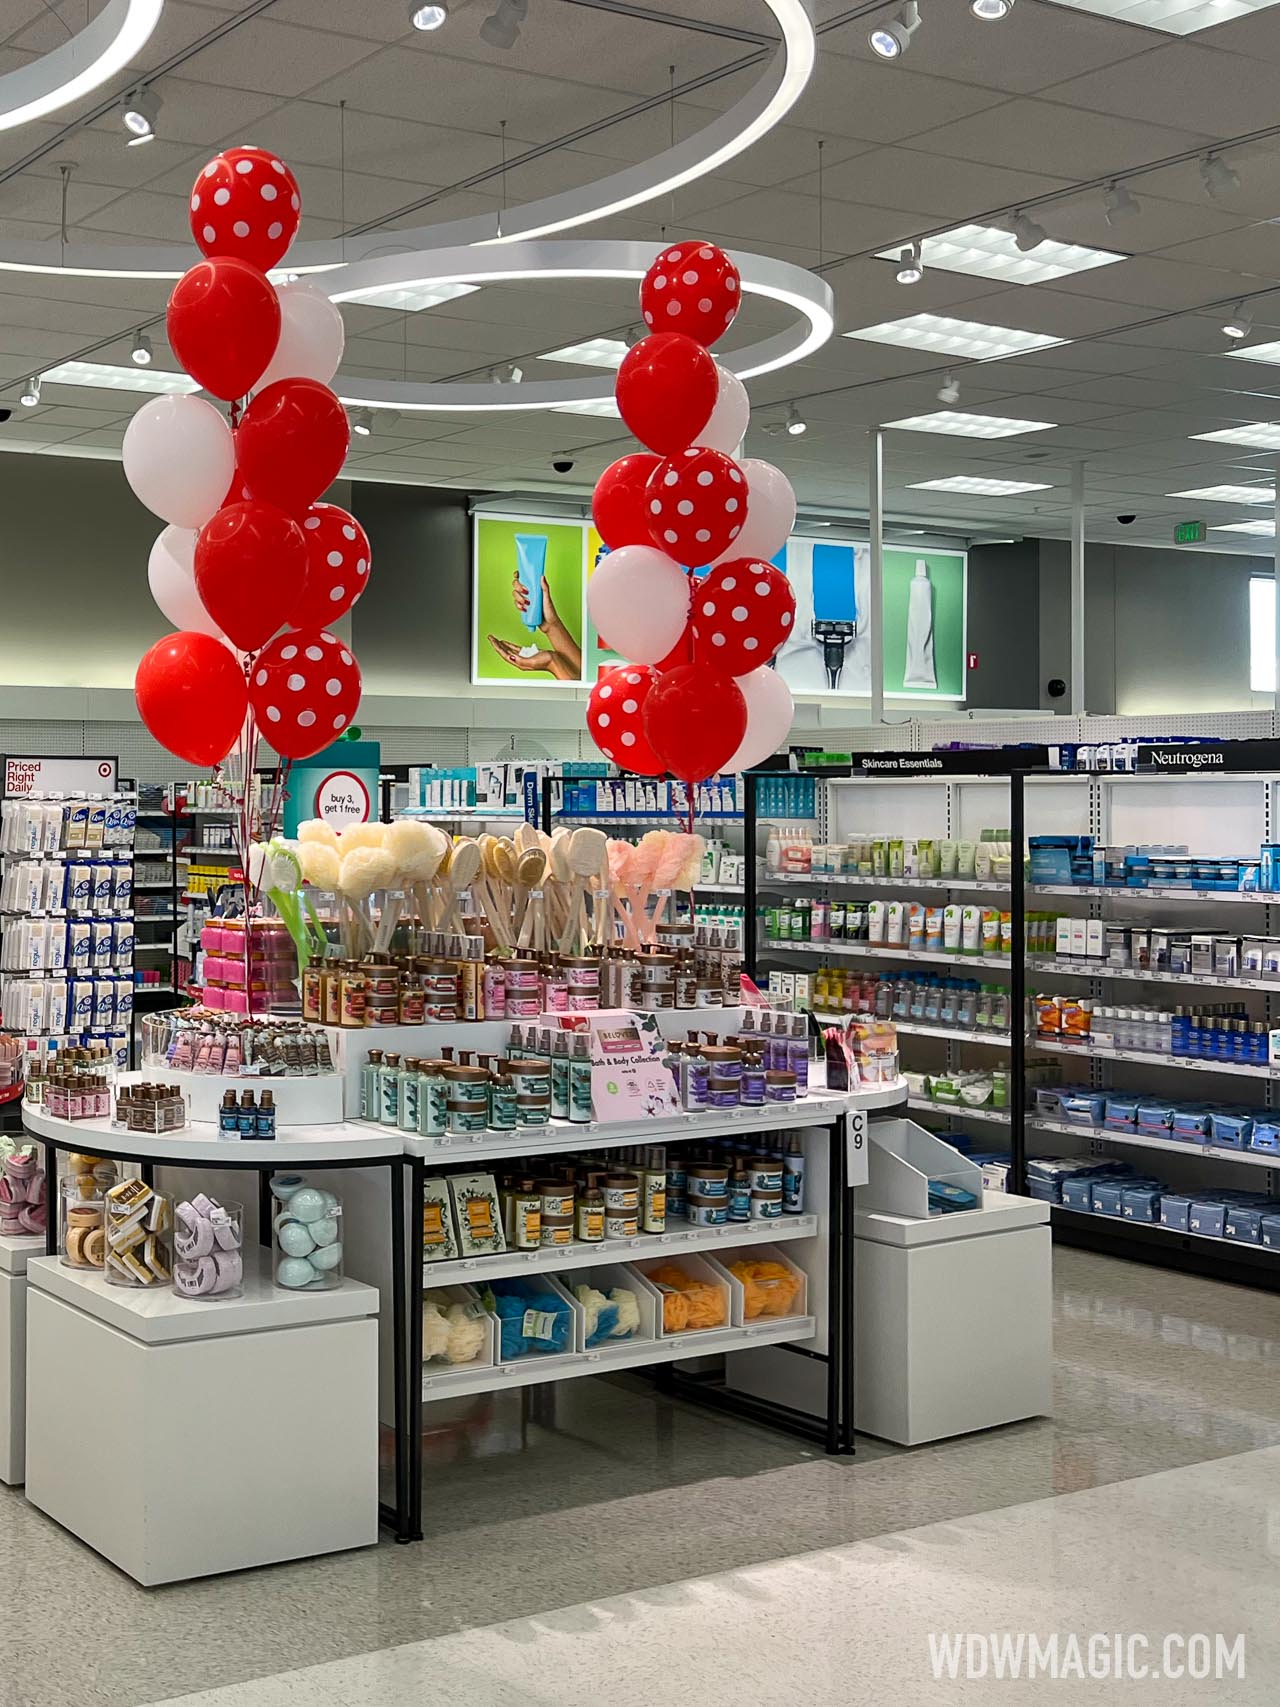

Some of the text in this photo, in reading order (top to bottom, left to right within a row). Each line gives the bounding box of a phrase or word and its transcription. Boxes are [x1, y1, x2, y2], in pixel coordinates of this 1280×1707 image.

[862, 758, 943, 769] Skincare Essentials
[1151, 750, 1224, 768] Neutrogena
[7, 762, 41, 772] Priced
[7, 772, 35, 784] Right
[7, 782, 33, 793] Daily
[331, 794, 354, 805] buy 3,
[324, 805, 360, 814] get 1 free
[614, 1057, 629, 1066] Body
[630, 1056, 660, 1064] Collection
